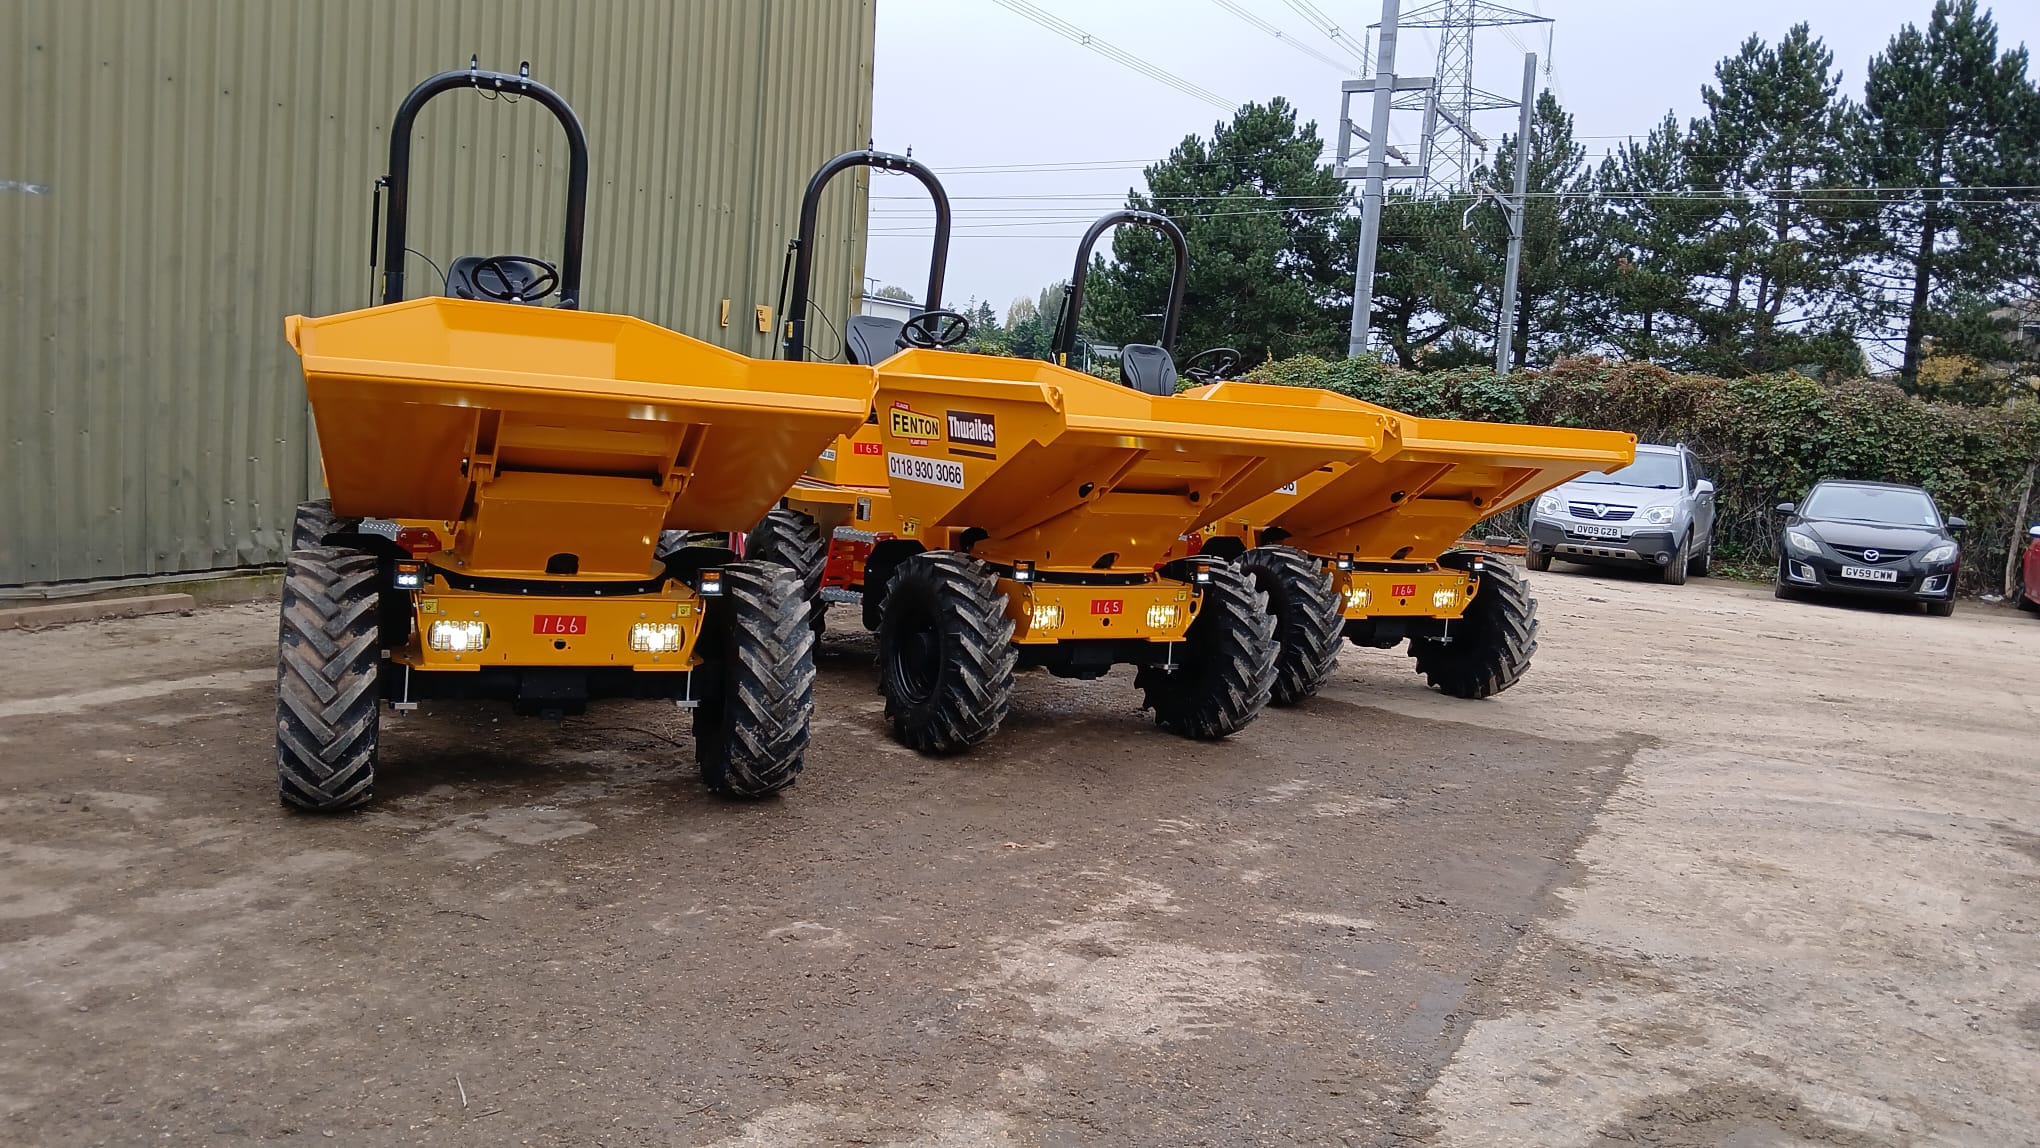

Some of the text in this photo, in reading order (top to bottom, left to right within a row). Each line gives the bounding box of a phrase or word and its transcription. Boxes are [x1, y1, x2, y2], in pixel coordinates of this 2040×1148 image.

[892, 413, 939, 435] FENTON
[948, 415, 994, 442] Thwaites
[859, 444, 879, 454] 165
[890, 457, 962, 484] 0118 930 3066
[1600, 527, 1618, 536] GZB
[1846, 567, 1871, 578] GV59
[1096, 601, 1119, 614] 165
[542, 616, 578, 633] 166
